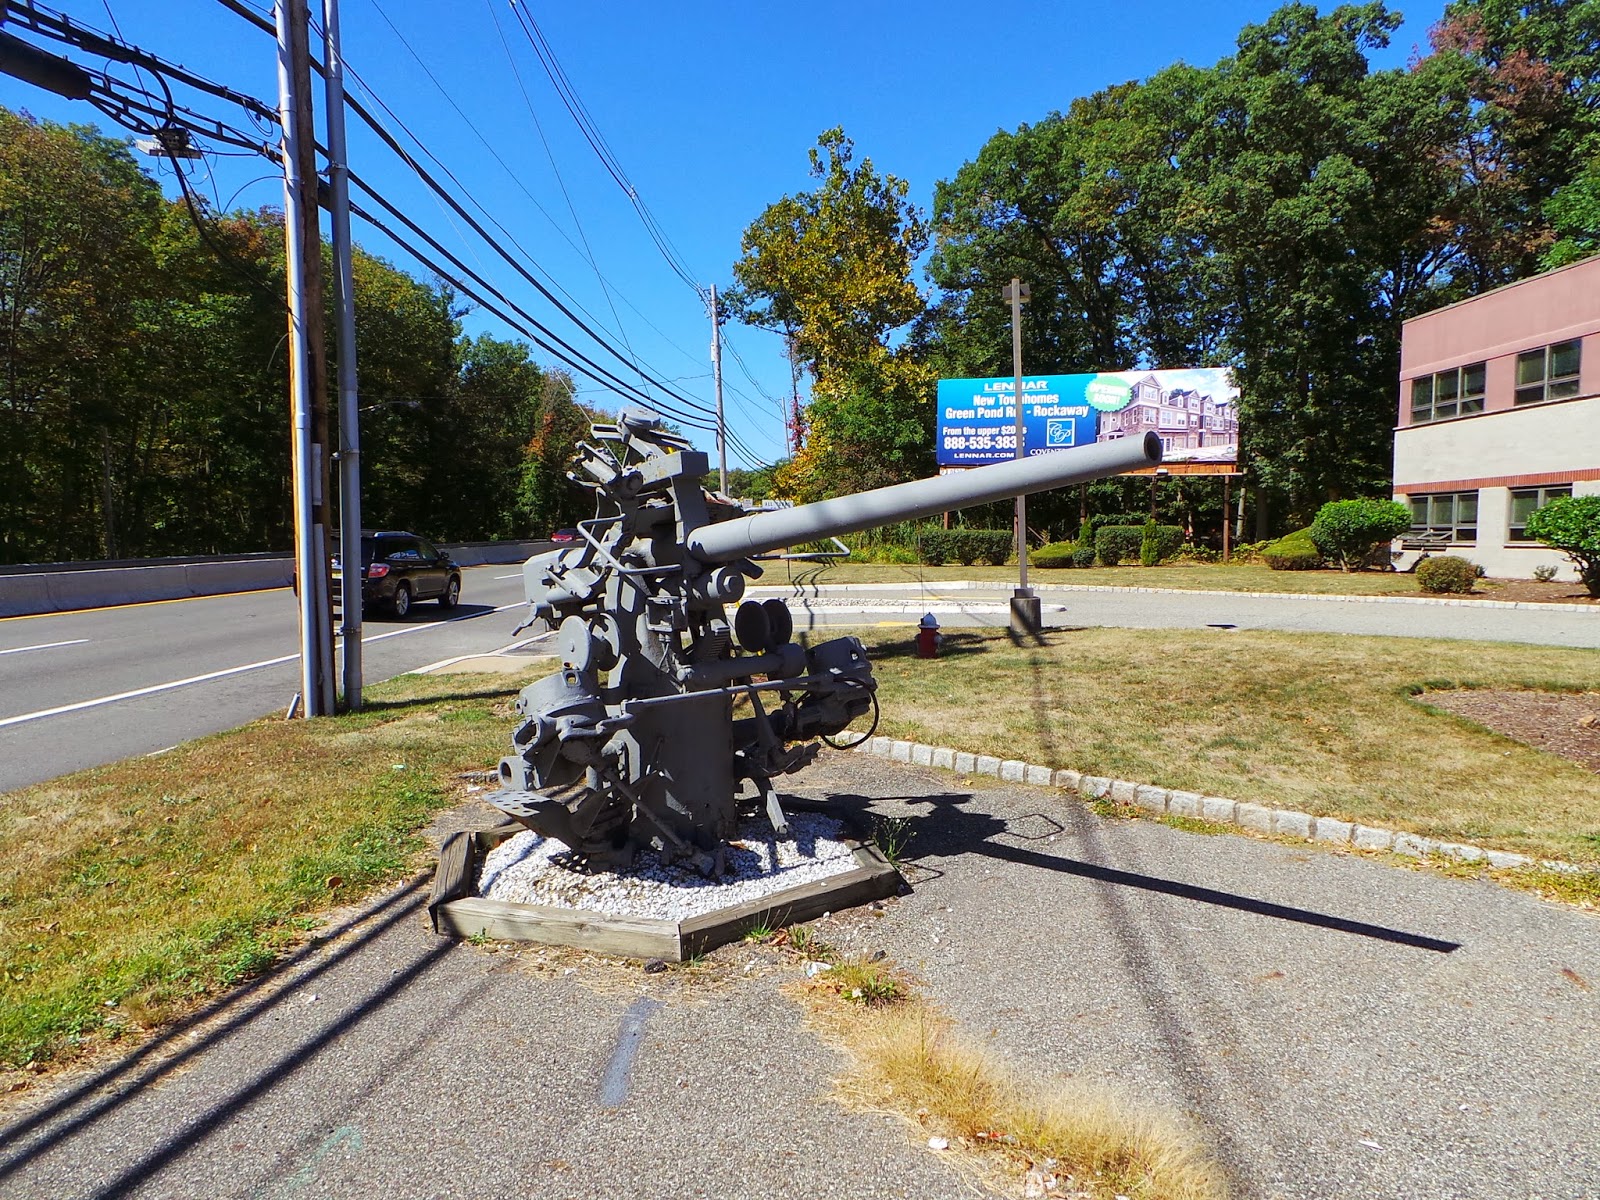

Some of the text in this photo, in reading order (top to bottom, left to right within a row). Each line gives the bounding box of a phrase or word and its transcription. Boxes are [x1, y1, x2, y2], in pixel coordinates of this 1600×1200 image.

[973, 395, 995, 407] New
[945, 408, 975, 419] Green
[977, 407, 1004, 419] Pond
[1033, 405, 1089, 418] Rockaway
[943, 426, 962, 436] From
[963, 426, 976, 436] the
[977, 427, 1000, 437] upper
